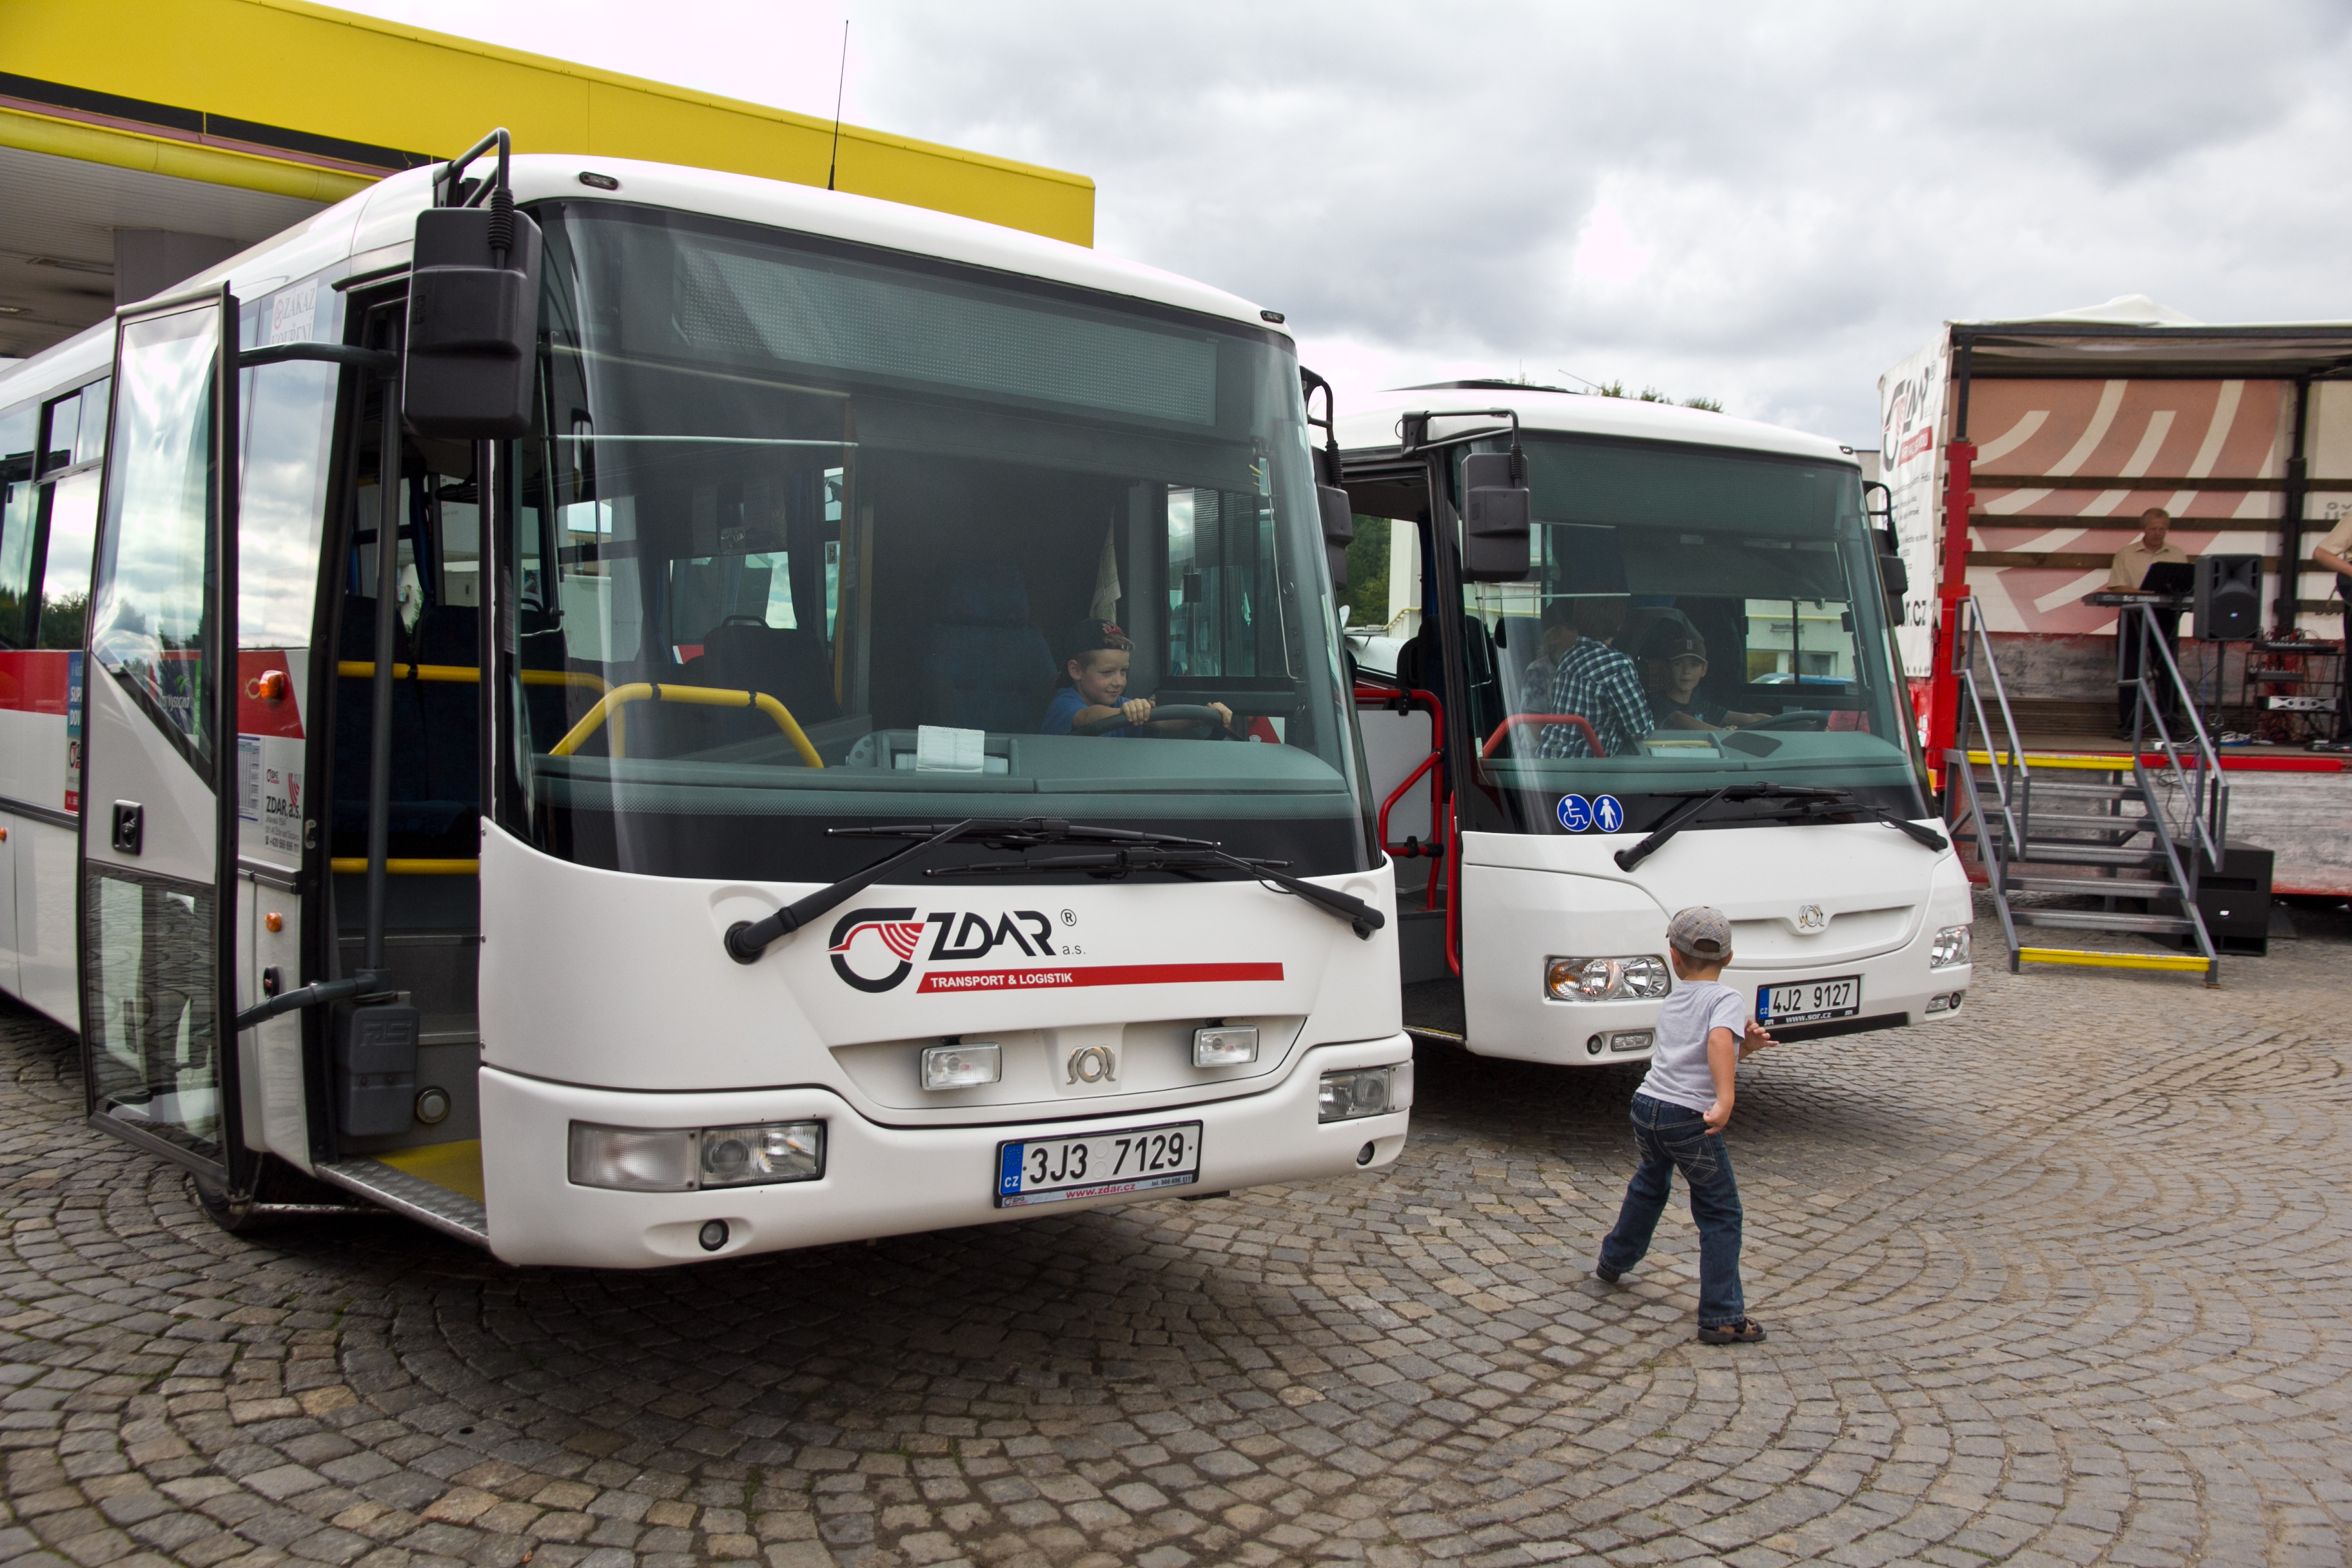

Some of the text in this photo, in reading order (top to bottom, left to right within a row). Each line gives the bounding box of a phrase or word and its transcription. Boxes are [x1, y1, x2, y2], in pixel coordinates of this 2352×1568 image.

[284, 288, 315, 319] ZÁKAZ
[289, 803, 301, 819] a.s.
[925, 910, 1057, 961] ZDAR
[1062, 943, 1086, 956] a.s.
[930, 972, 1073, 988] TRANSPORT & LOGISTIK
[1772, 983, 1851, 1013] 4J2 9127
[1786, 1012, 1832, 1023] www.sor.cz
[1030, 1132, 1184, 1184] 3J3 7129
[1004, 1175, 1019, 1189] CZ
[1066, 1183, 1135, 1199] www.zdar.cz
